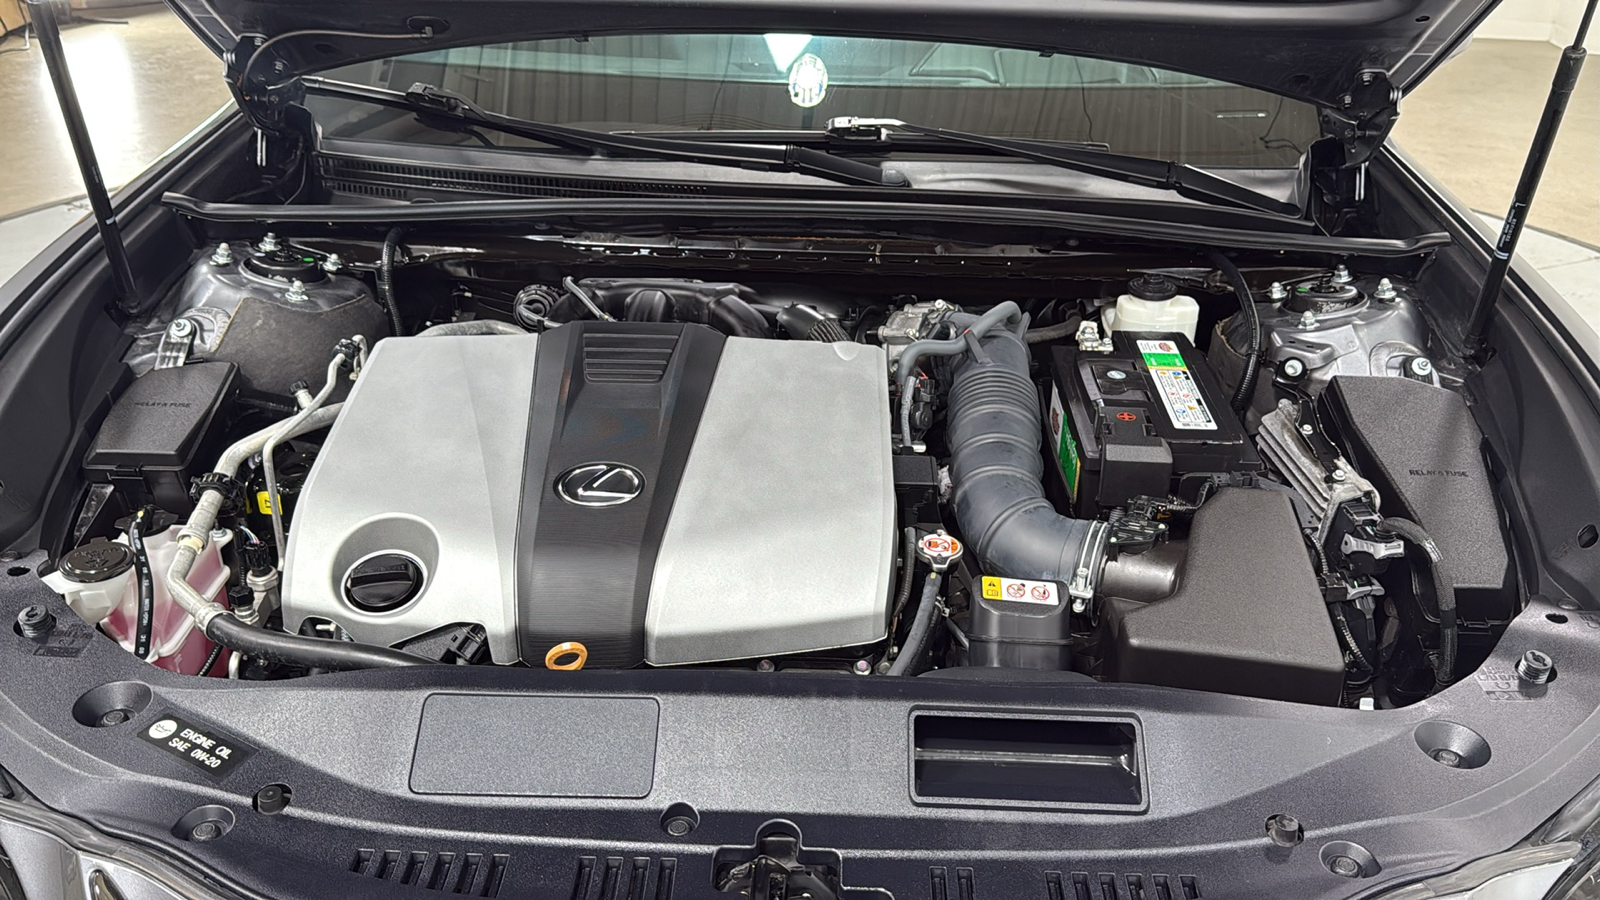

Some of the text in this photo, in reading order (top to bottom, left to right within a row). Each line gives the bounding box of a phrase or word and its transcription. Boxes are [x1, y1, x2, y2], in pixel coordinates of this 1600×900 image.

[168, 737, 221, 768] SAE 0W-20
[180, 728, 232, 760] ENGINE OIL
